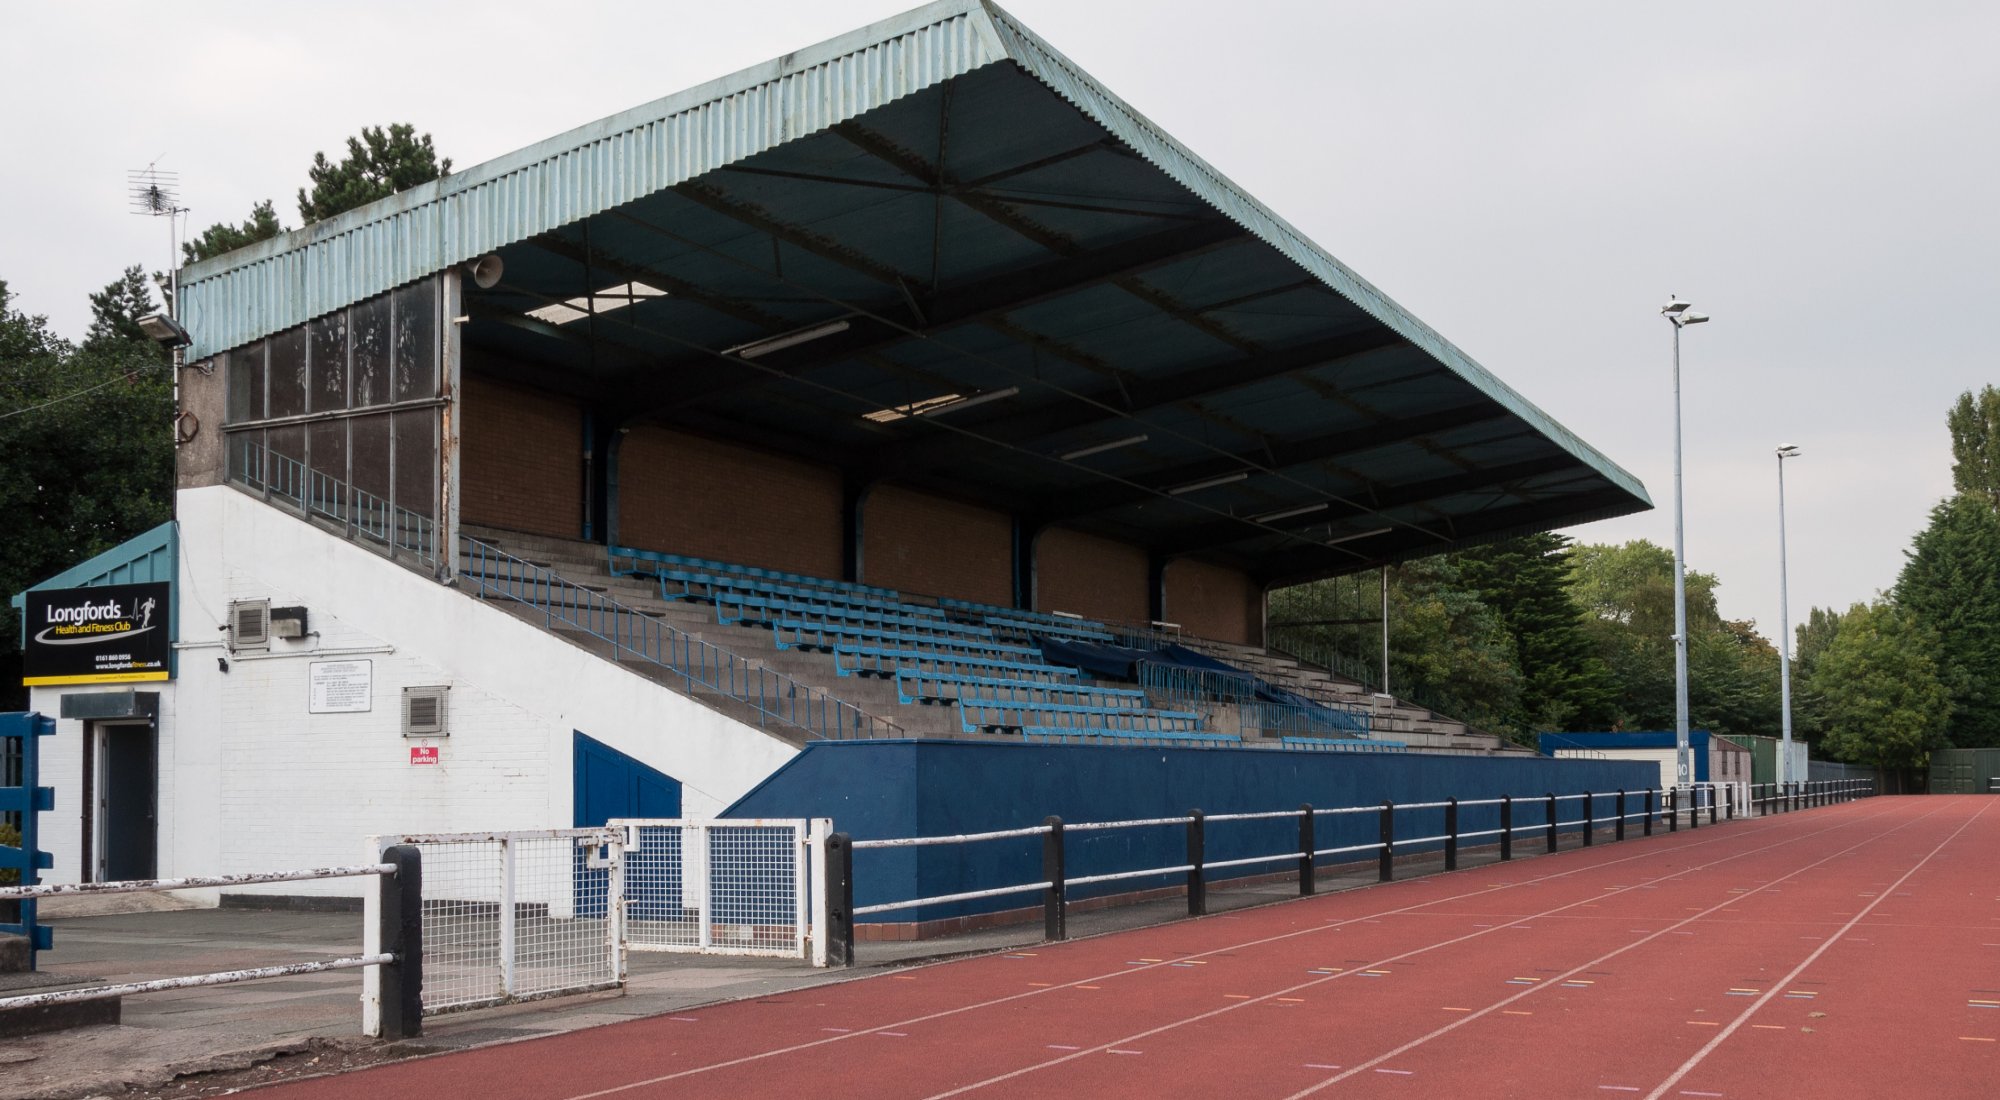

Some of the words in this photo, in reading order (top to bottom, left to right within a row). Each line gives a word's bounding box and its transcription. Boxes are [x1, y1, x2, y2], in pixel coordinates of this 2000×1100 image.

[47, 599, 121, 626] Longfords
[55, 624, 78, 635] Health
[78, 623, 91, 633] and
[92, 622, 114, 633] Fitness
[114, 621, 131, 631] Club
[95, 660, 161, 670] www.longfordsfitness.co.uk
[412, 756, 437, 764] parking
[1678, 763, 1688, 777] 10
